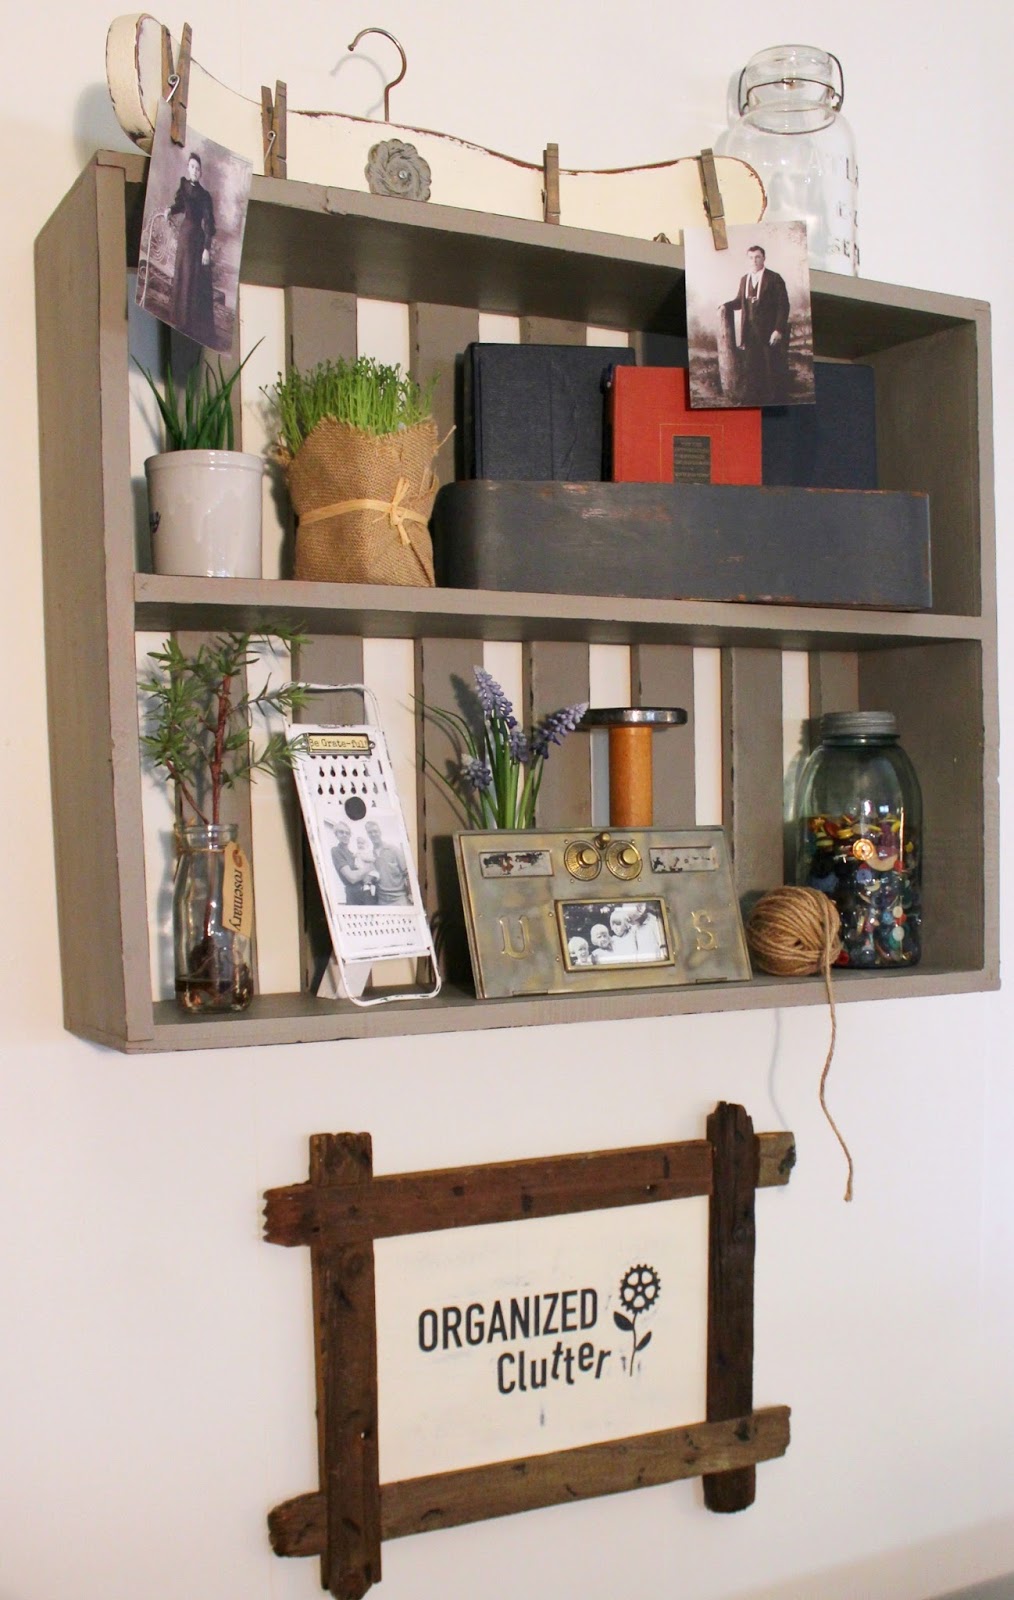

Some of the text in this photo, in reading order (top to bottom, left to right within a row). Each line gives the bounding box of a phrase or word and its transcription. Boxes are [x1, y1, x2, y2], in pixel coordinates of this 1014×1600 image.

[229, 869, 244, 931] rosemary
[418, 1288, 598, 1352] ORGANIZED
[497, 1341, 611, 1394] Clutter
